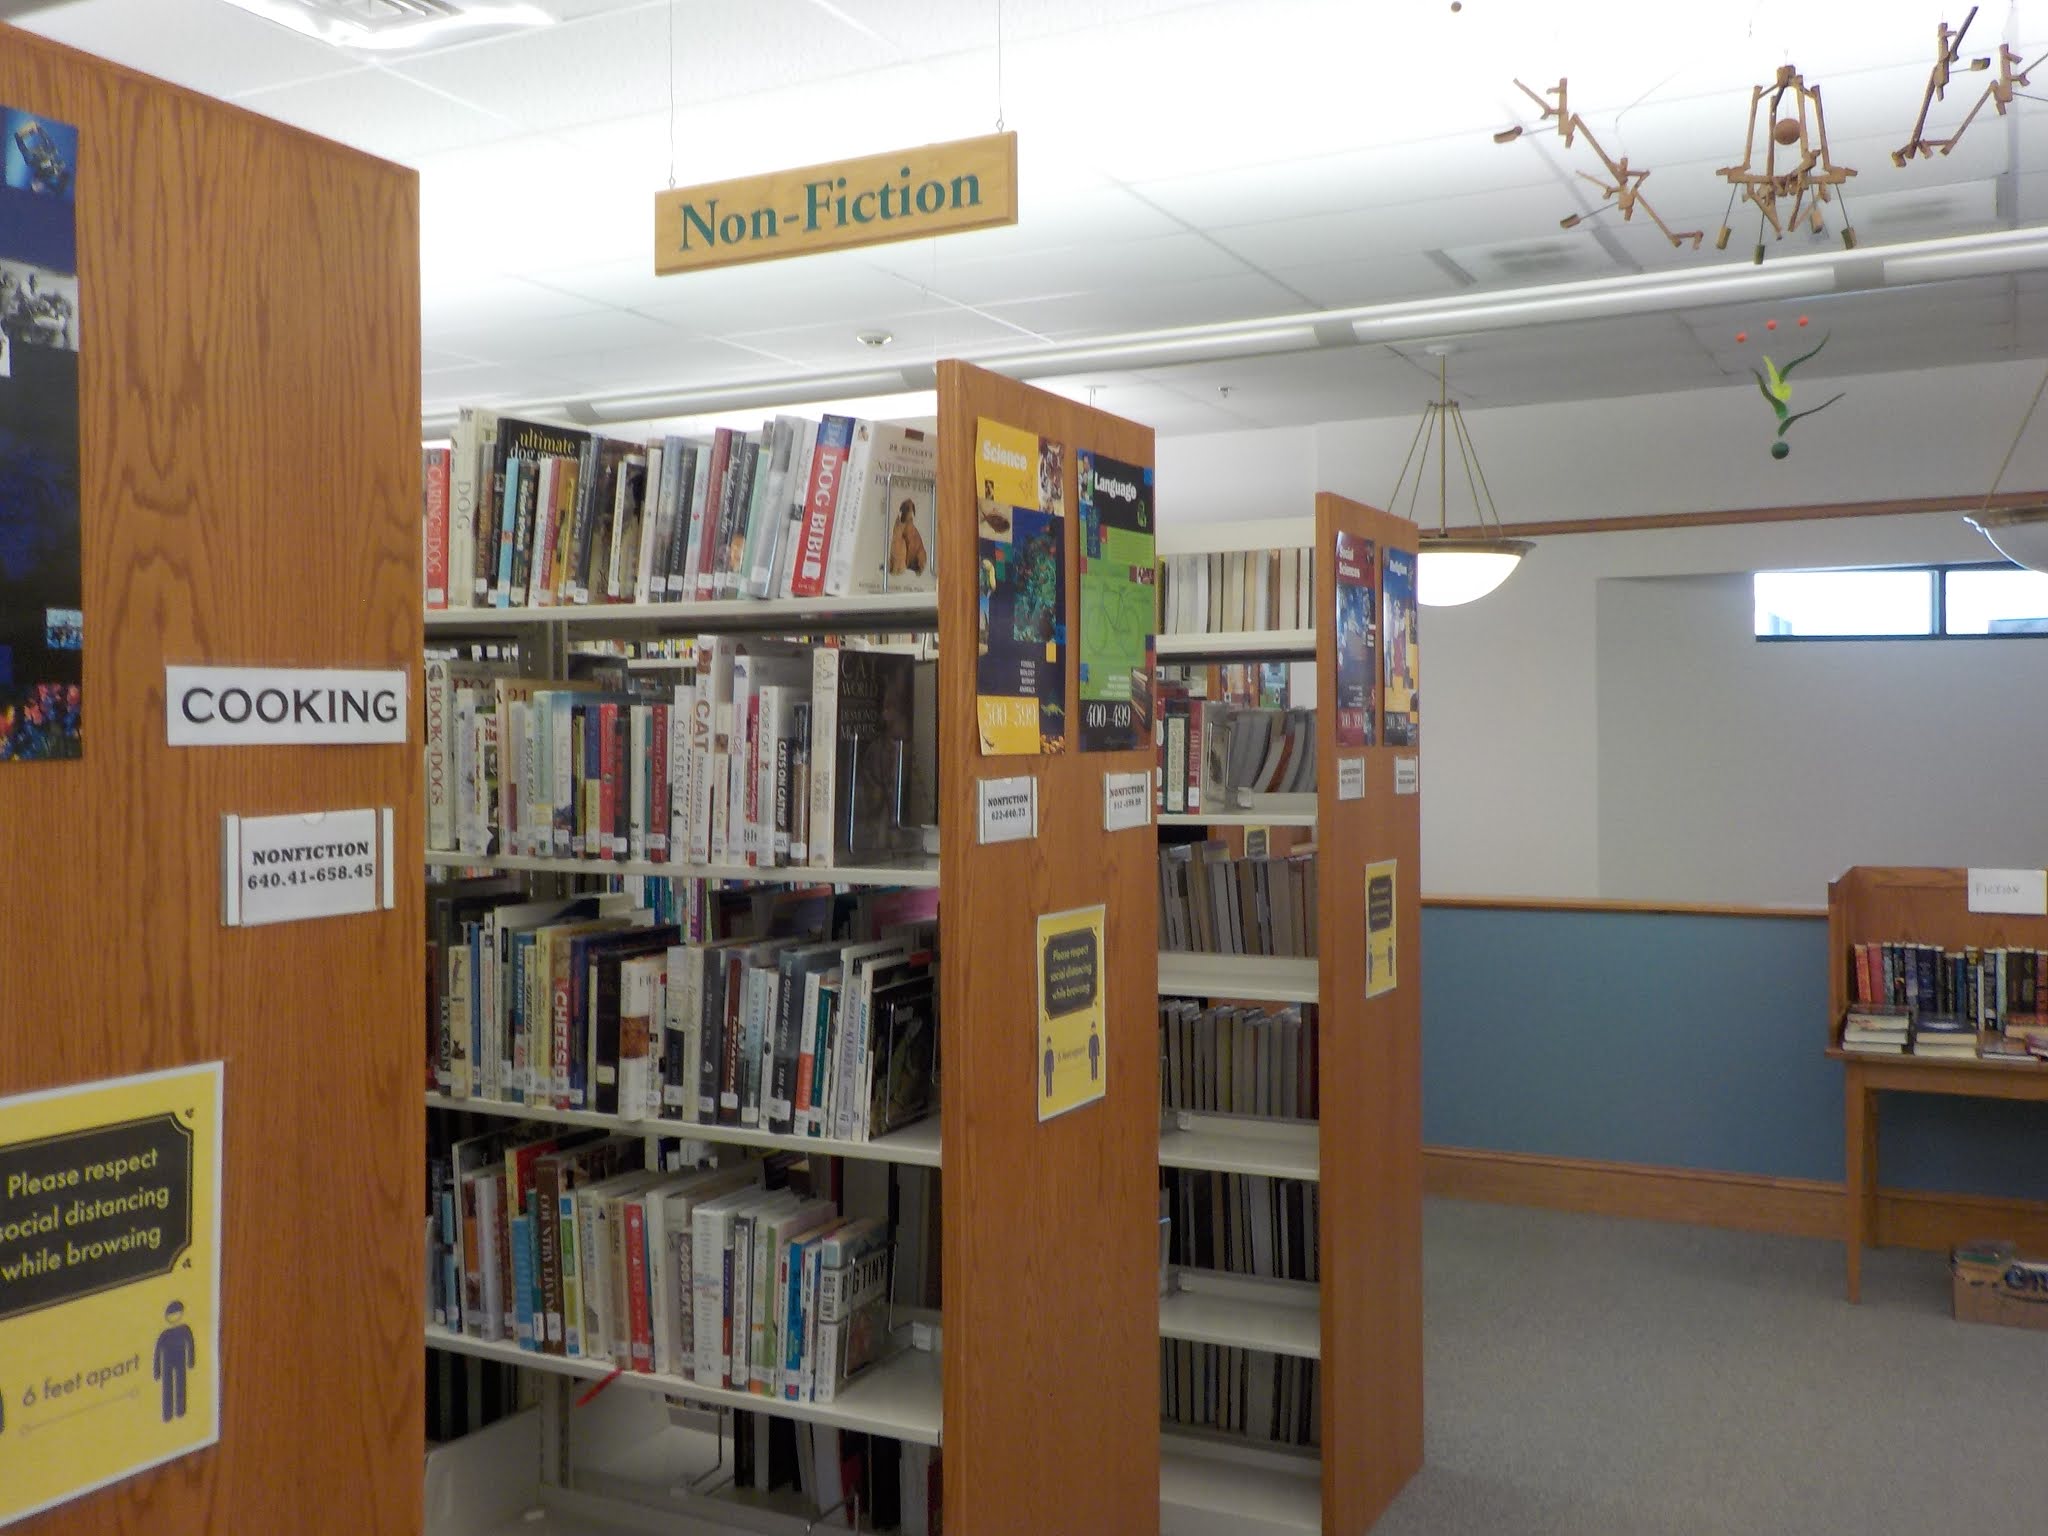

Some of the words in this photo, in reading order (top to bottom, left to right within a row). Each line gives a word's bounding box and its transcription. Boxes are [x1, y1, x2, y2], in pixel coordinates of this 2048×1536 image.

[678, 165, 984, 252] Non-Fiction
[519, 427, 575, 456] ultimate
[982, 440, 1027, 471] Science
[815, 452, 838, 506] DOG
[1094, 471, 1137, 503] Language
[457, 480, 472, 531] DOG
[181, 687, 399, 724] COOKING
[429, 685, 443, 744] BOOK
[695, 700, 711, 752] CAT
[777, 741, 787, 769] CATS
[429, 751, 443, 806] DOGS
[673, 754, 685, 804] SENSE
[777, 769, 786, 786] ON
[1109, 783, 1145, 799] NONFICTION
[776, 787, 786, 827] CATNIP
[987, 793, 1029, 808] NONFICTION
[251, 840, 370, 867] NONFICTION
[246, 862, 375, 891] 640.41-658.45
[554, 990, 569, 1079] CHEESE
[7, 1166, 79, 1199] Please
[84, 1147, 159, 1184] respect
[65, 1184, 170, 1228] distancing
[1, 1247, 61, 1282] while
[66, 1224, 162, 1268] browsing
[541, 1266, 554, 1312] LIVIN
[841, 1266, 861, 1303] BG
[21, 1386, 37, 1408] 6
[43, 1369, 82, 1402] feet
[86, 1353, 141, 1390] apart
